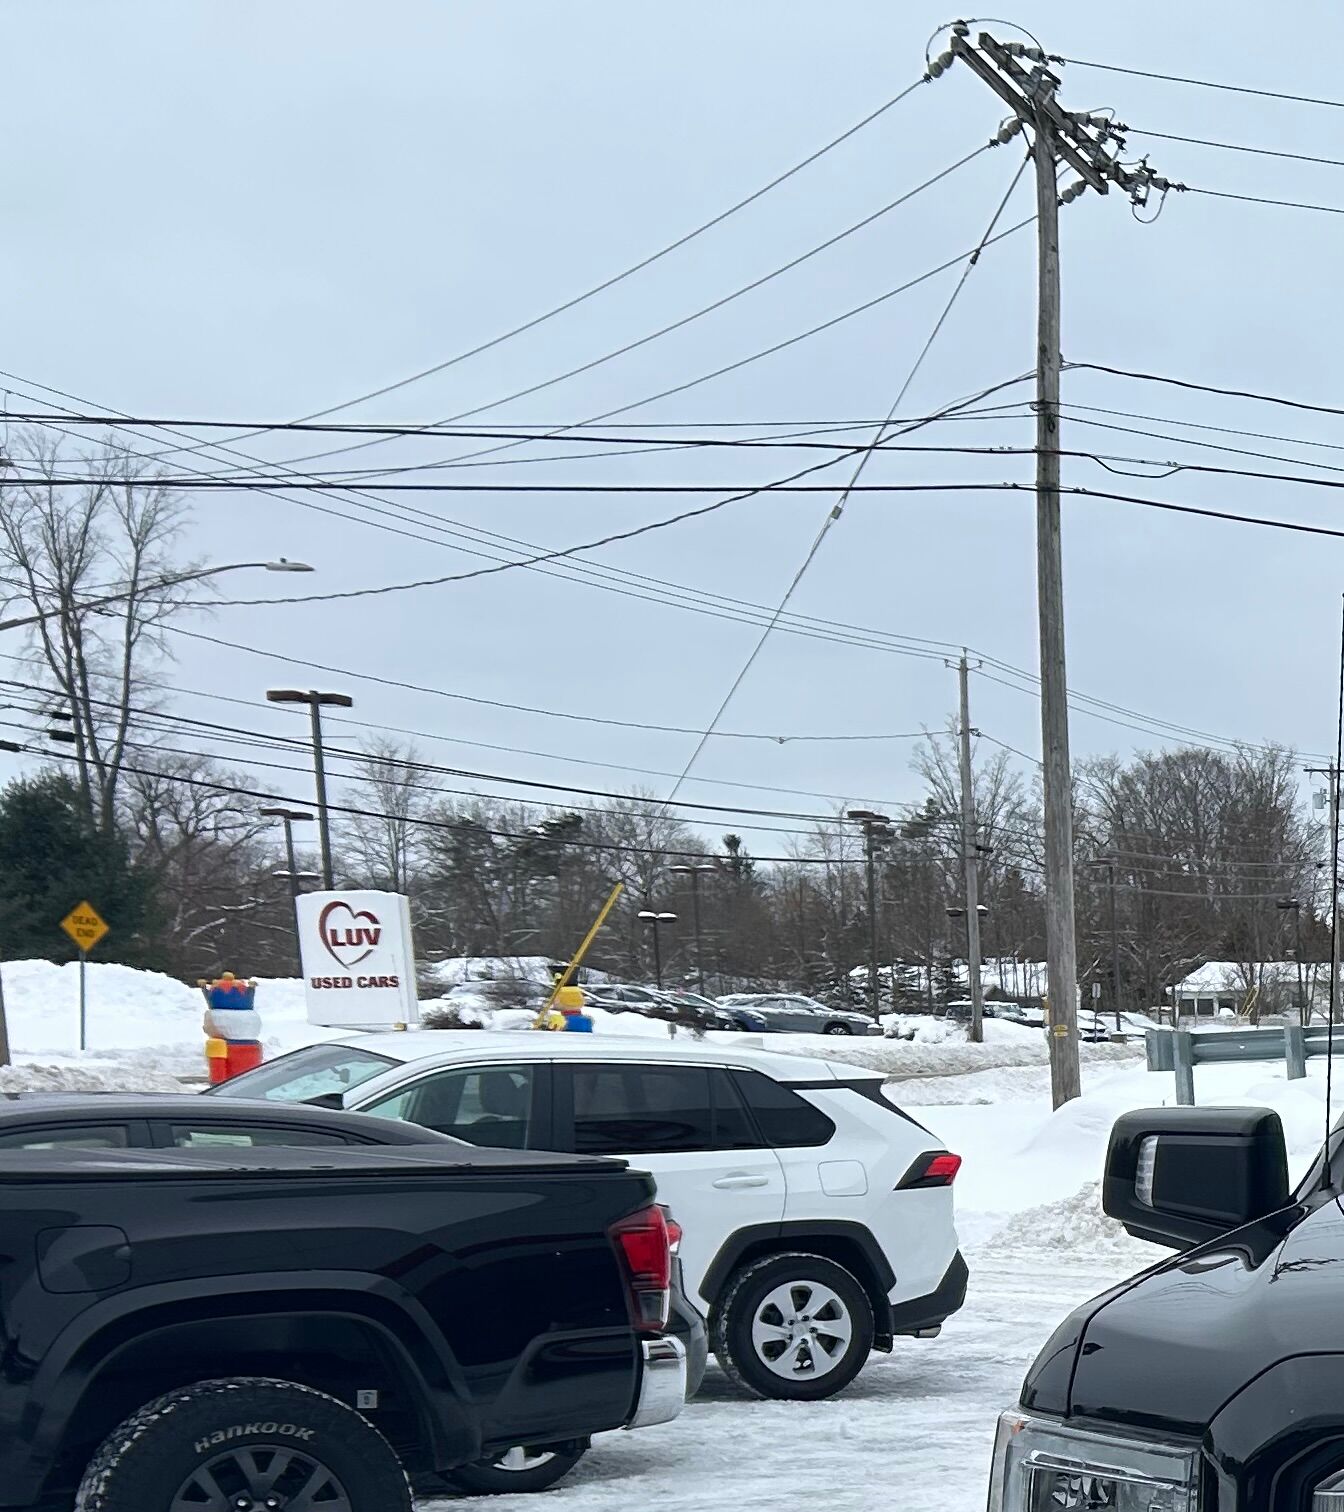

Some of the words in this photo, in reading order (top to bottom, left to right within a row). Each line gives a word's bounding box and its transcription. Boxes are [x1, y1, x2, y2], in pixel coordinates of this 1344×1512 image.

[72, 915, 98, 926] DEAD
[76, 928, 96, 938] END
[329, 928, 382, 947] LUV
[311, 976, 353, 989] USED
[357, 975, 399, 988] CARS
